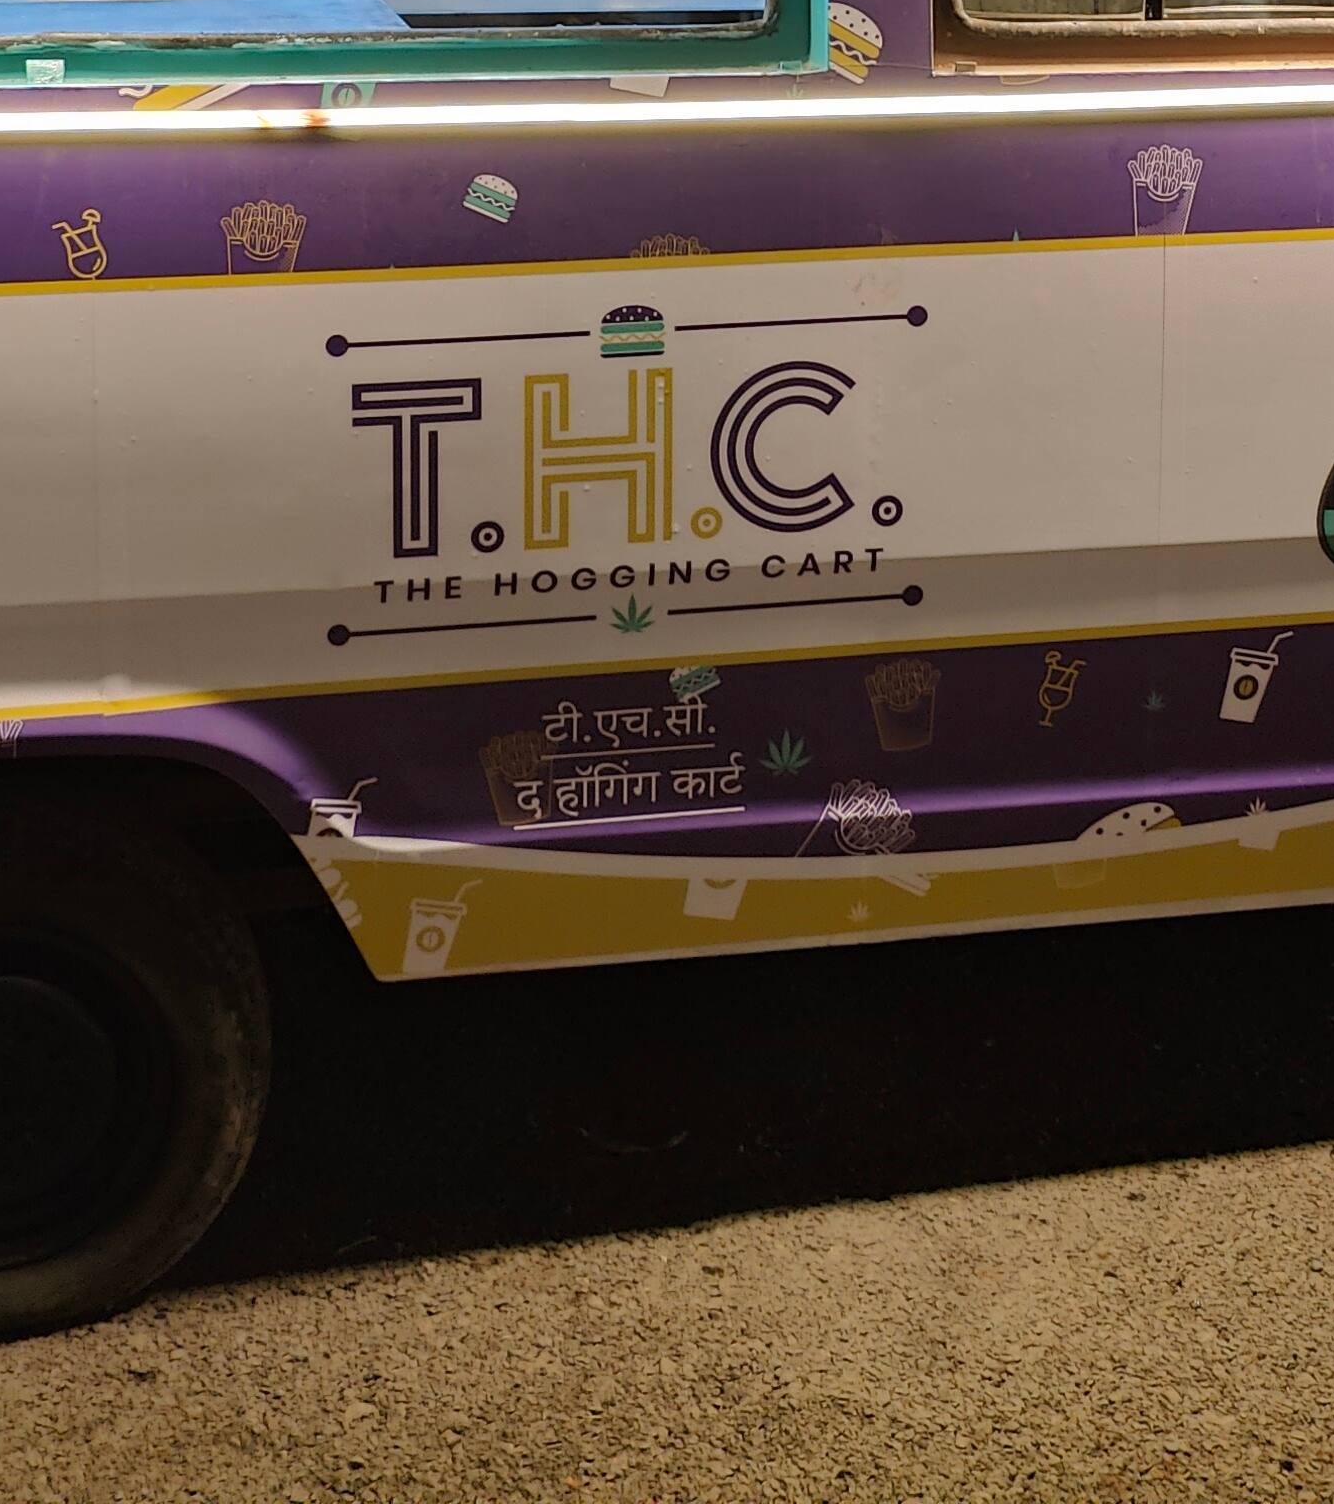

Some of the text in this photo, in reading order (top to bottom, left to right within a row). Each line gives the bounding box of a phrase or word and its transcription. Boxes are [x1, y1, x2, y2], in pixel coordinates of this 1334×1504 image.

[351, 359, 904, 559] T.H.C.
[374, 547, 888, 603] THE HOGGING CART
[669, 751, 746, 800] कार्ट
